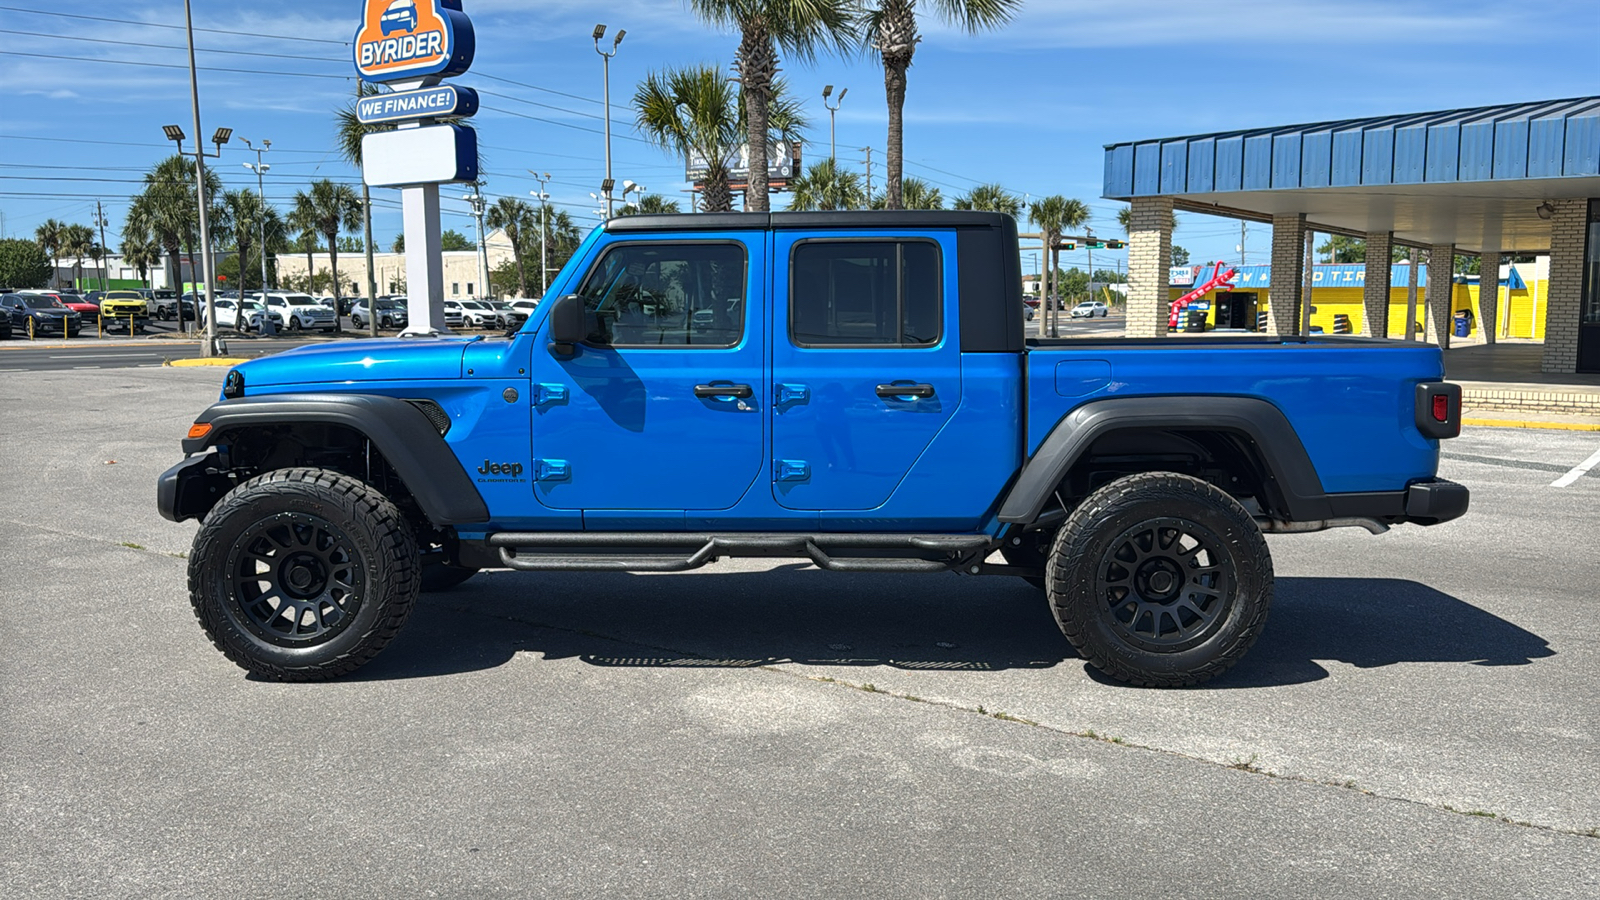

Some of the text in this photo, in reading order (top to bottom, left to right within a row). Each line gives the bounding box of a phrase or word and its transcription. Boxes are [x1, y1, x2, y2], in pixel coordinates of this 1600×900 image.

[360, 31, 442, 66] BYRIDER
[361, 92, 450, 116] WE FINANCE!
[477, 459, 523, 477] Jeep
